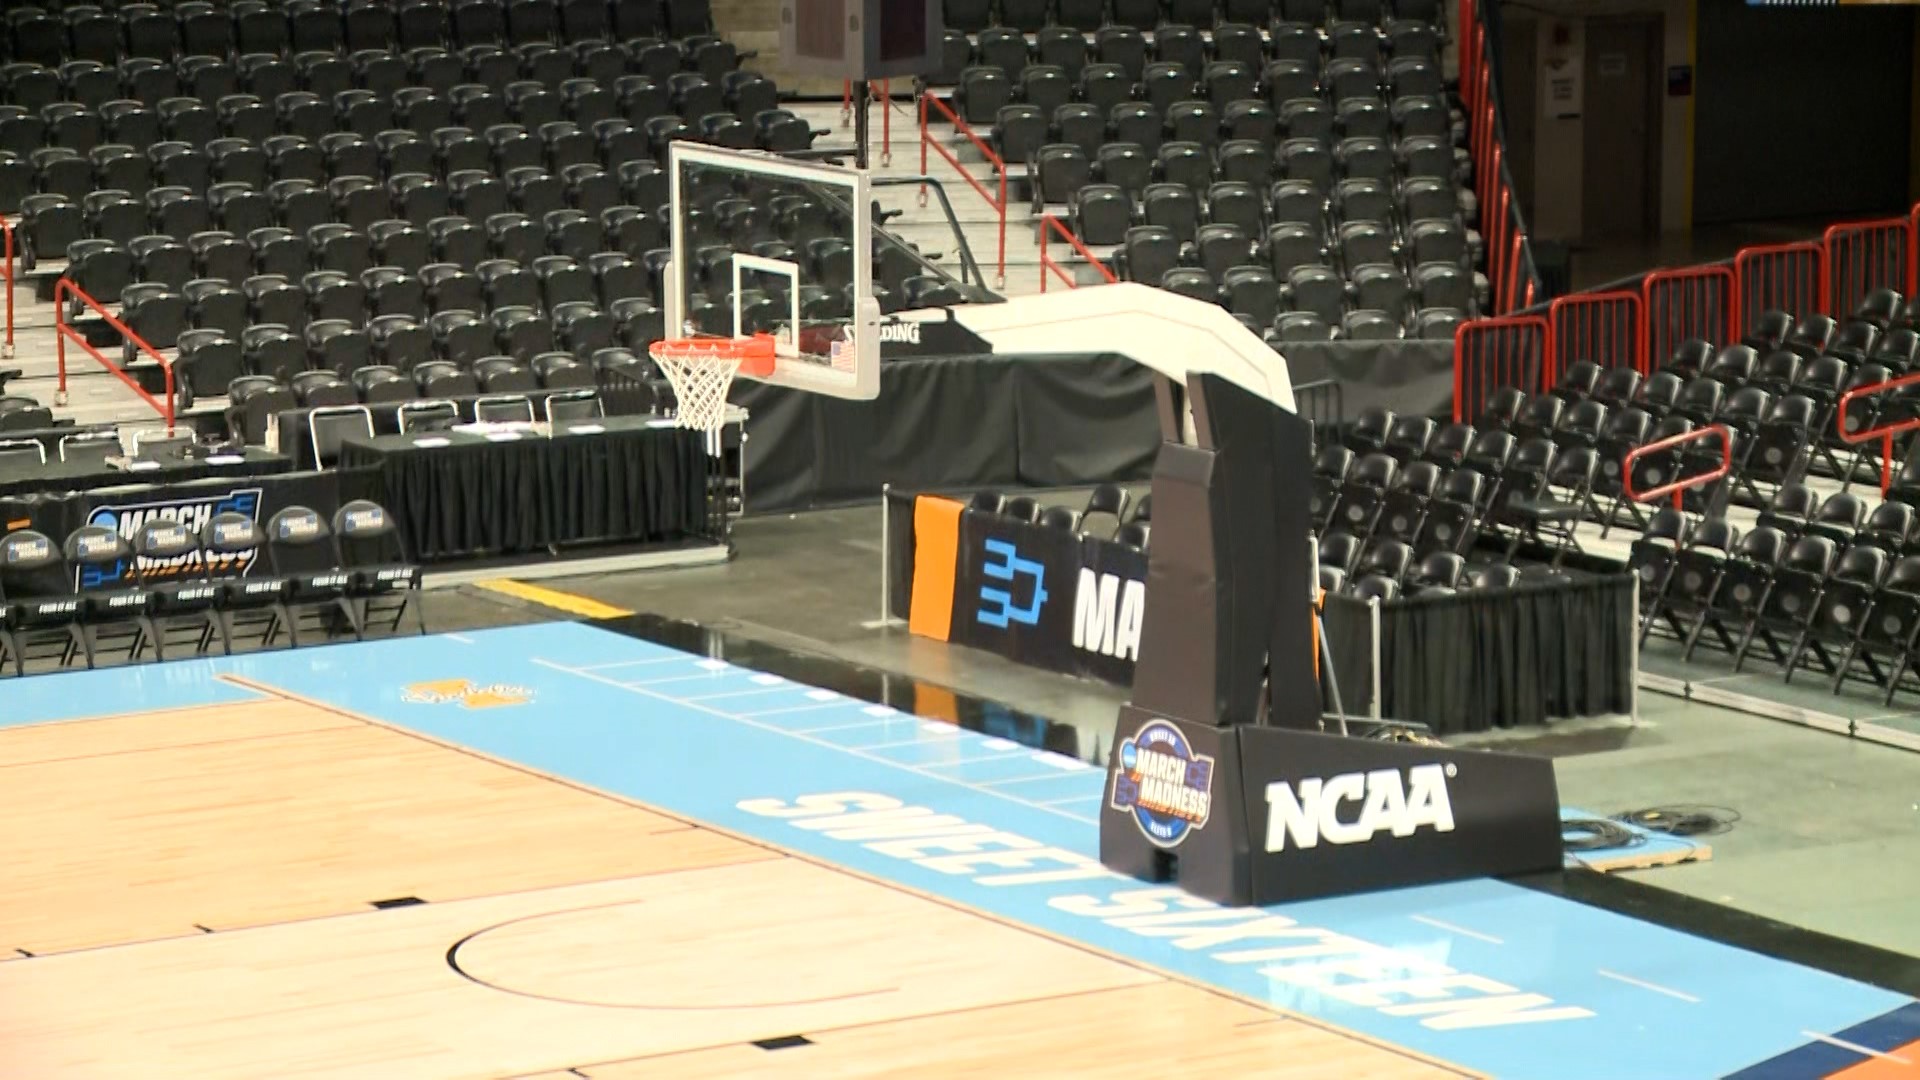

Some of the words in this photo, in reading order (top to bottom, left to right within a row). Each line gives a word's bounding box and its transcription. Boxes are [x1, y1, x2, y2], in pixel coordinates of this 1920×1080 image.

[843, 323, 920, 344] SDING
[1135, 747, 1186, 785] MARCH
[1140, 776, 1208, 818] MADNESS
[1265, 763, 1455, 853] NCAA
[736, 791, 1135, 886] SWEET
[1047, 887, 1598, 1031] SIXTEEN
